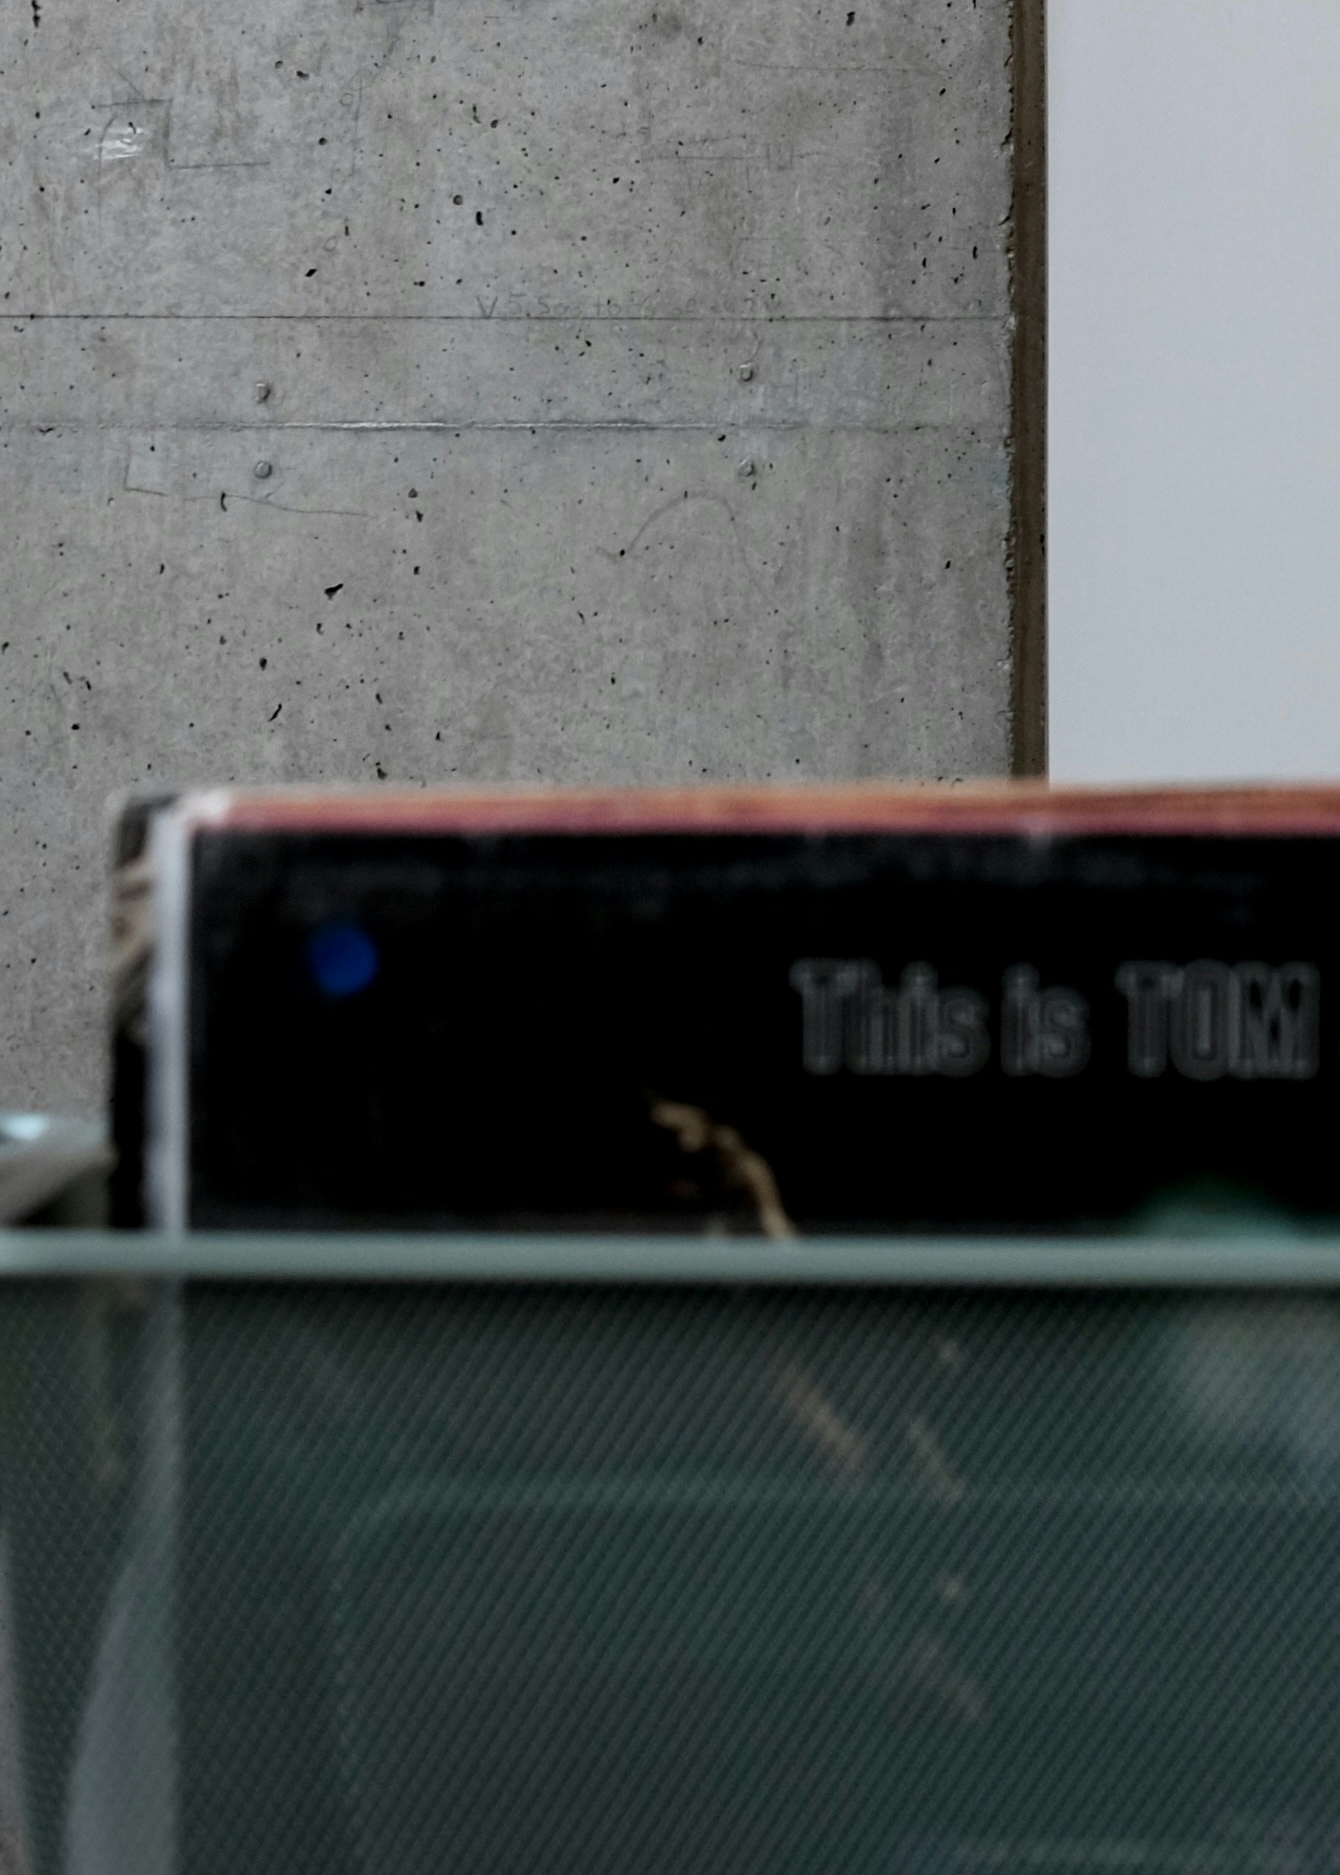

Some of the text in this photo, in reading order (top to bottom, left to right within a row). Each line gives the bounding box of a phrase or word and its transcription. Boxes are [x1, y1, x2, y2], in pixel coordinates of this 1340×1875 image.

[789, 958, 991, 1076] This
[1002, 962, 1089, 1076] is
[1115, 960, 1320, 1080] TOM
